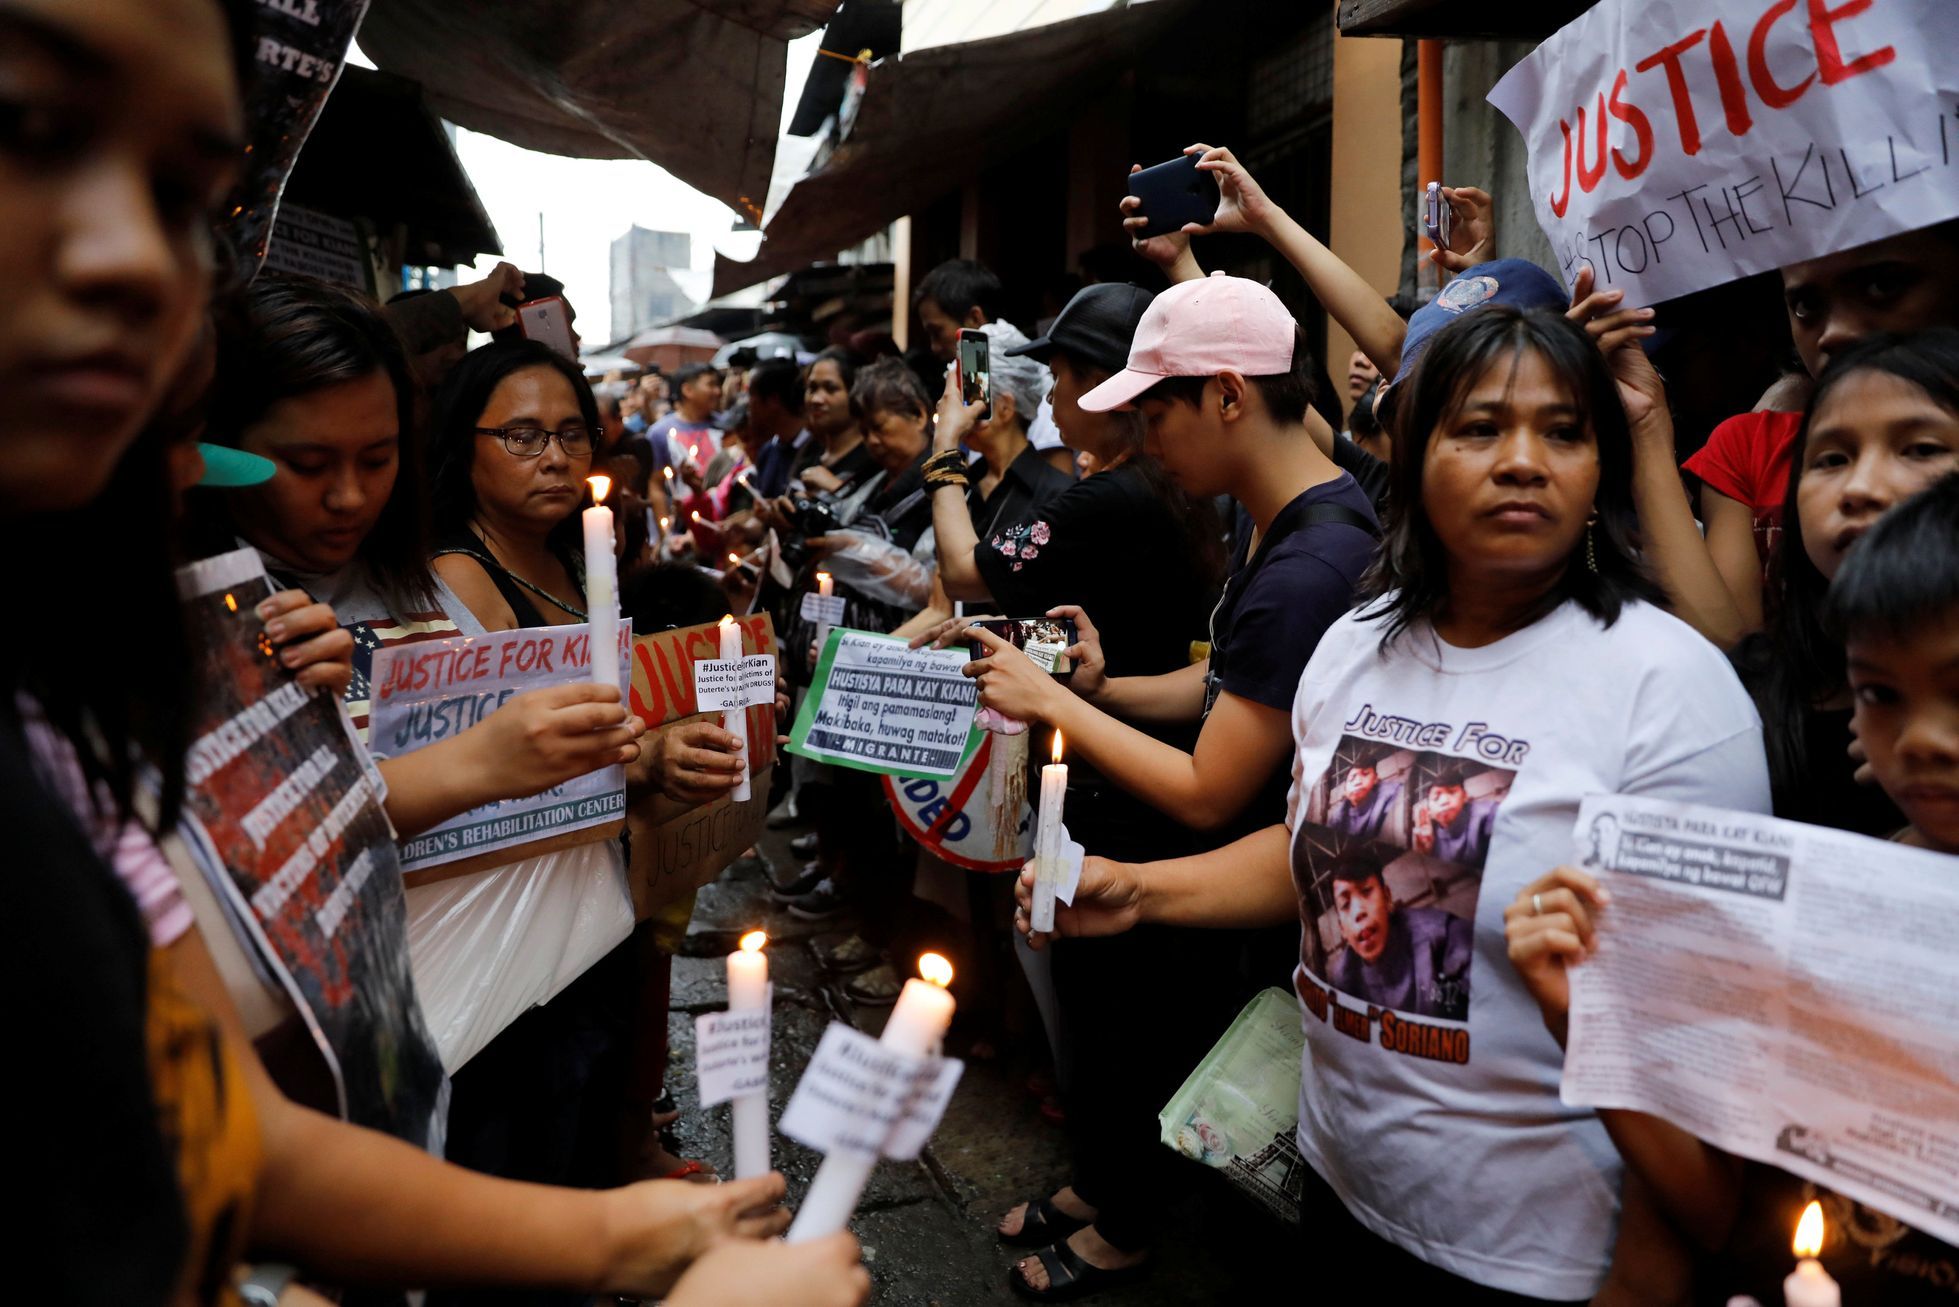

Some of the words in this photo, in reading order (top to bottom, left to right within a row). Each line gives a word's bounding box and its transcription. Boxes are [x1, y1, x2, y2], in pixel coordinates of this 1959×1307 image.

[1551, 0, 1896, 219] JUSTICE
[379, 645, 494, 699] JUSTICE
[499, 638, 554, 679] FOR
[562, 624, 630, 667] KI!
[698, 675, 723, 683] Justice
[764, 669, 772, 677] of
[867, 652, 912, 669] kapamilya
[914, 660, 927, 672] ng
[930, 662, 960, 673] bawat
[698, 685, 729, 694] Duterte's
[830, 670, 881, 691] HUSTISYA
[883, 678, 912, 696] PARA
[914, 680, 939, 699] KAY
[940, 683, 976, 703] KIAN!
[815, 710, 874, 736] Makibaka,
[878, 720, 914, 744] huwag
[918, 728, 967, 746] matakot!
[862, 700, 879, 716] ang
[881, 703, 957, 726] pamamaslang!
[402, 831, 458, 860] DREN'S
[463, 805, 574, 846] REHABILITATION
[578, 793, 624, 818] CENTER
[1380, 1009, 1470, 1065] SORIANO
